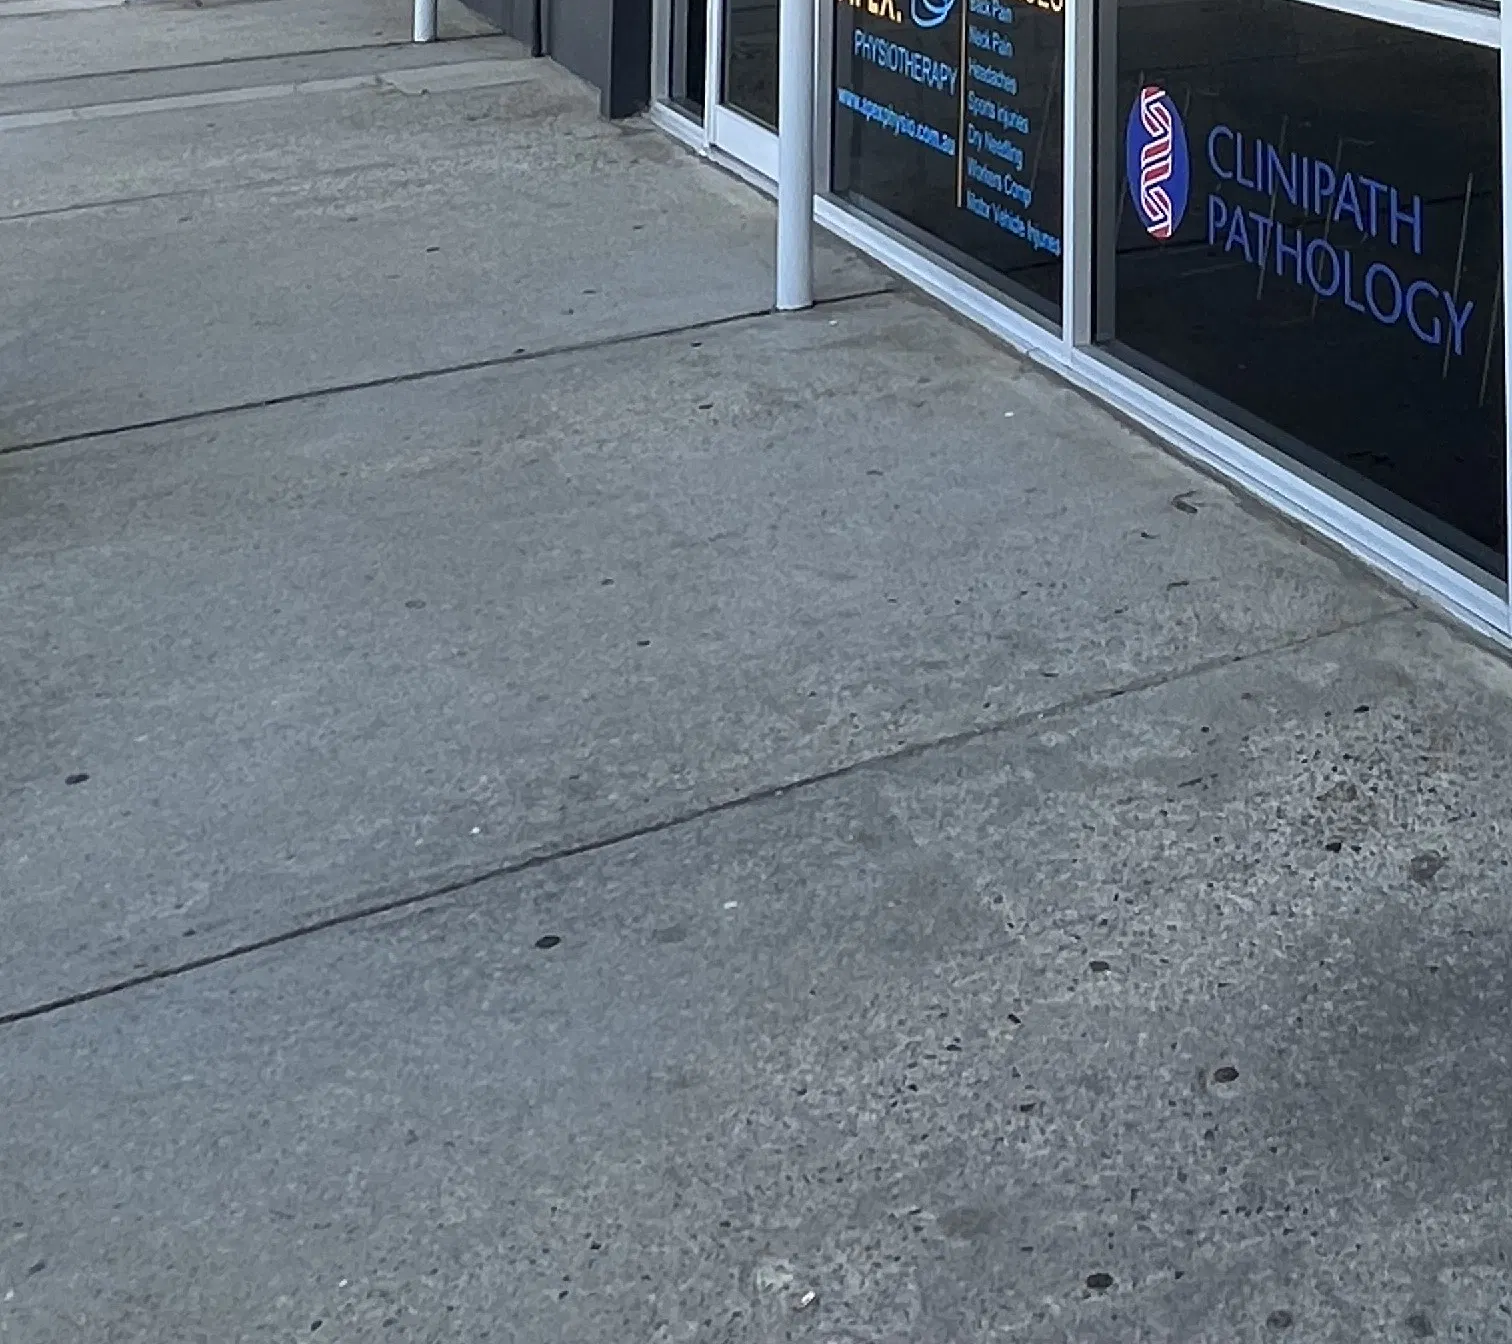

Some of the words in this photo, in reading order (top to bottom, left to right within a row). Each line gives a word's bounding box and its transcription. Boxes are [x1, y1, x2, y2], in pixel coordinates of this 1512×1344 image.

[854, 28, 957, 96] PHYSIOTHERAPY
[1208, 124, 1422, 255] CLINIPATH
[1208, 194, 1474, 357] PATHOLOGY
